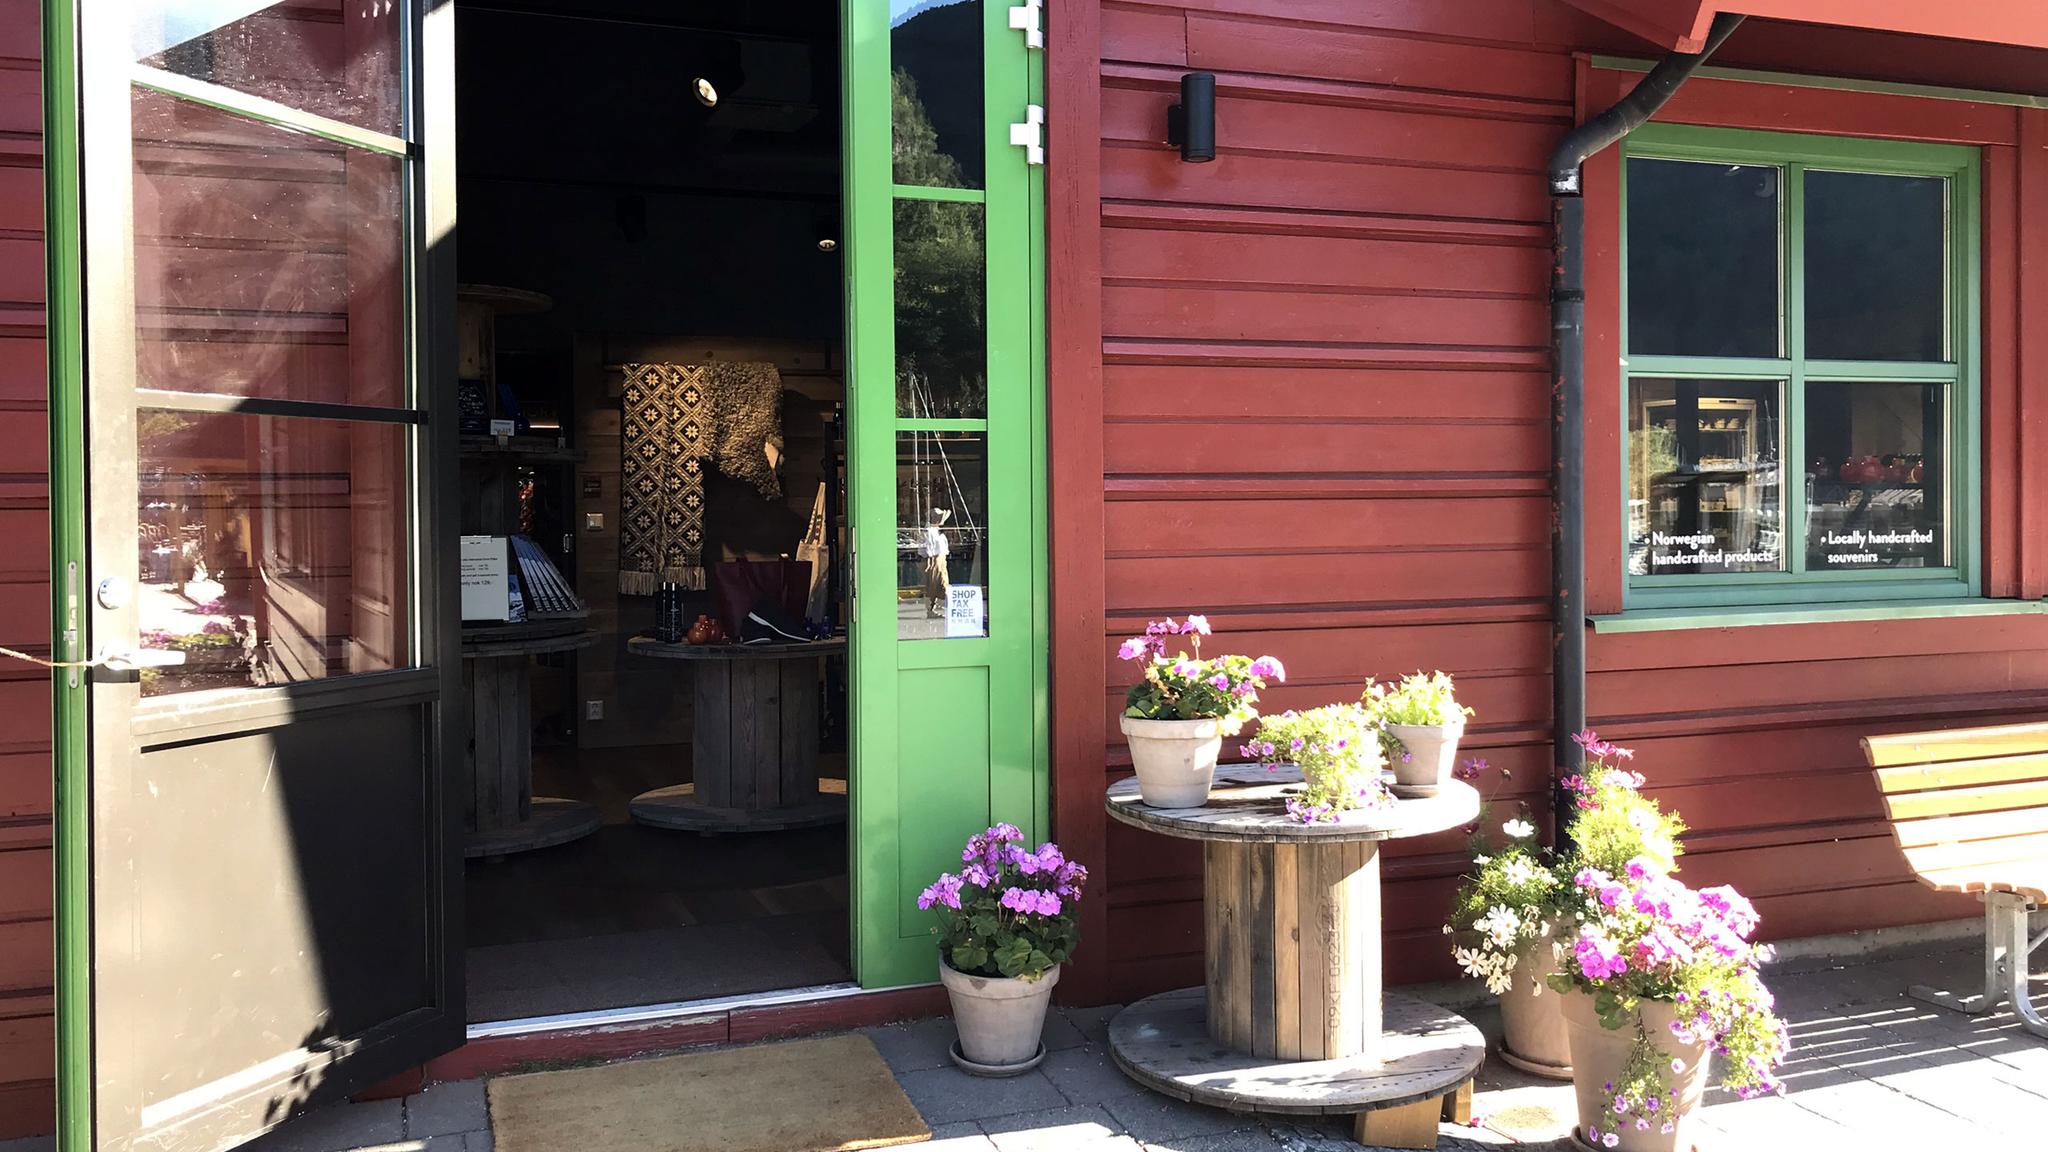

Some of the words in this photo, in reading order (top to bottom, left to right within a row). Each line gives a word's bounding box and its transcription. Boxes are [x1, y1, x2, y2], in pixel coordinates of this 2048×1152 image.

[1652, 531, 1715, 550] Norwegian
[1828, 530, 1866, 549] Locally
[1868, 529, 1933, 544] handcrafted
[1652, 549, 1722, 566] handcrafted
[1724, 548, 1774, 567] products
[1827, 549, 1879, 563] souvenirs
[952, 590, 976, 599] SHOP
[952, 600, 969, 608] TAX
[951, 609, 974, 617] FREE
